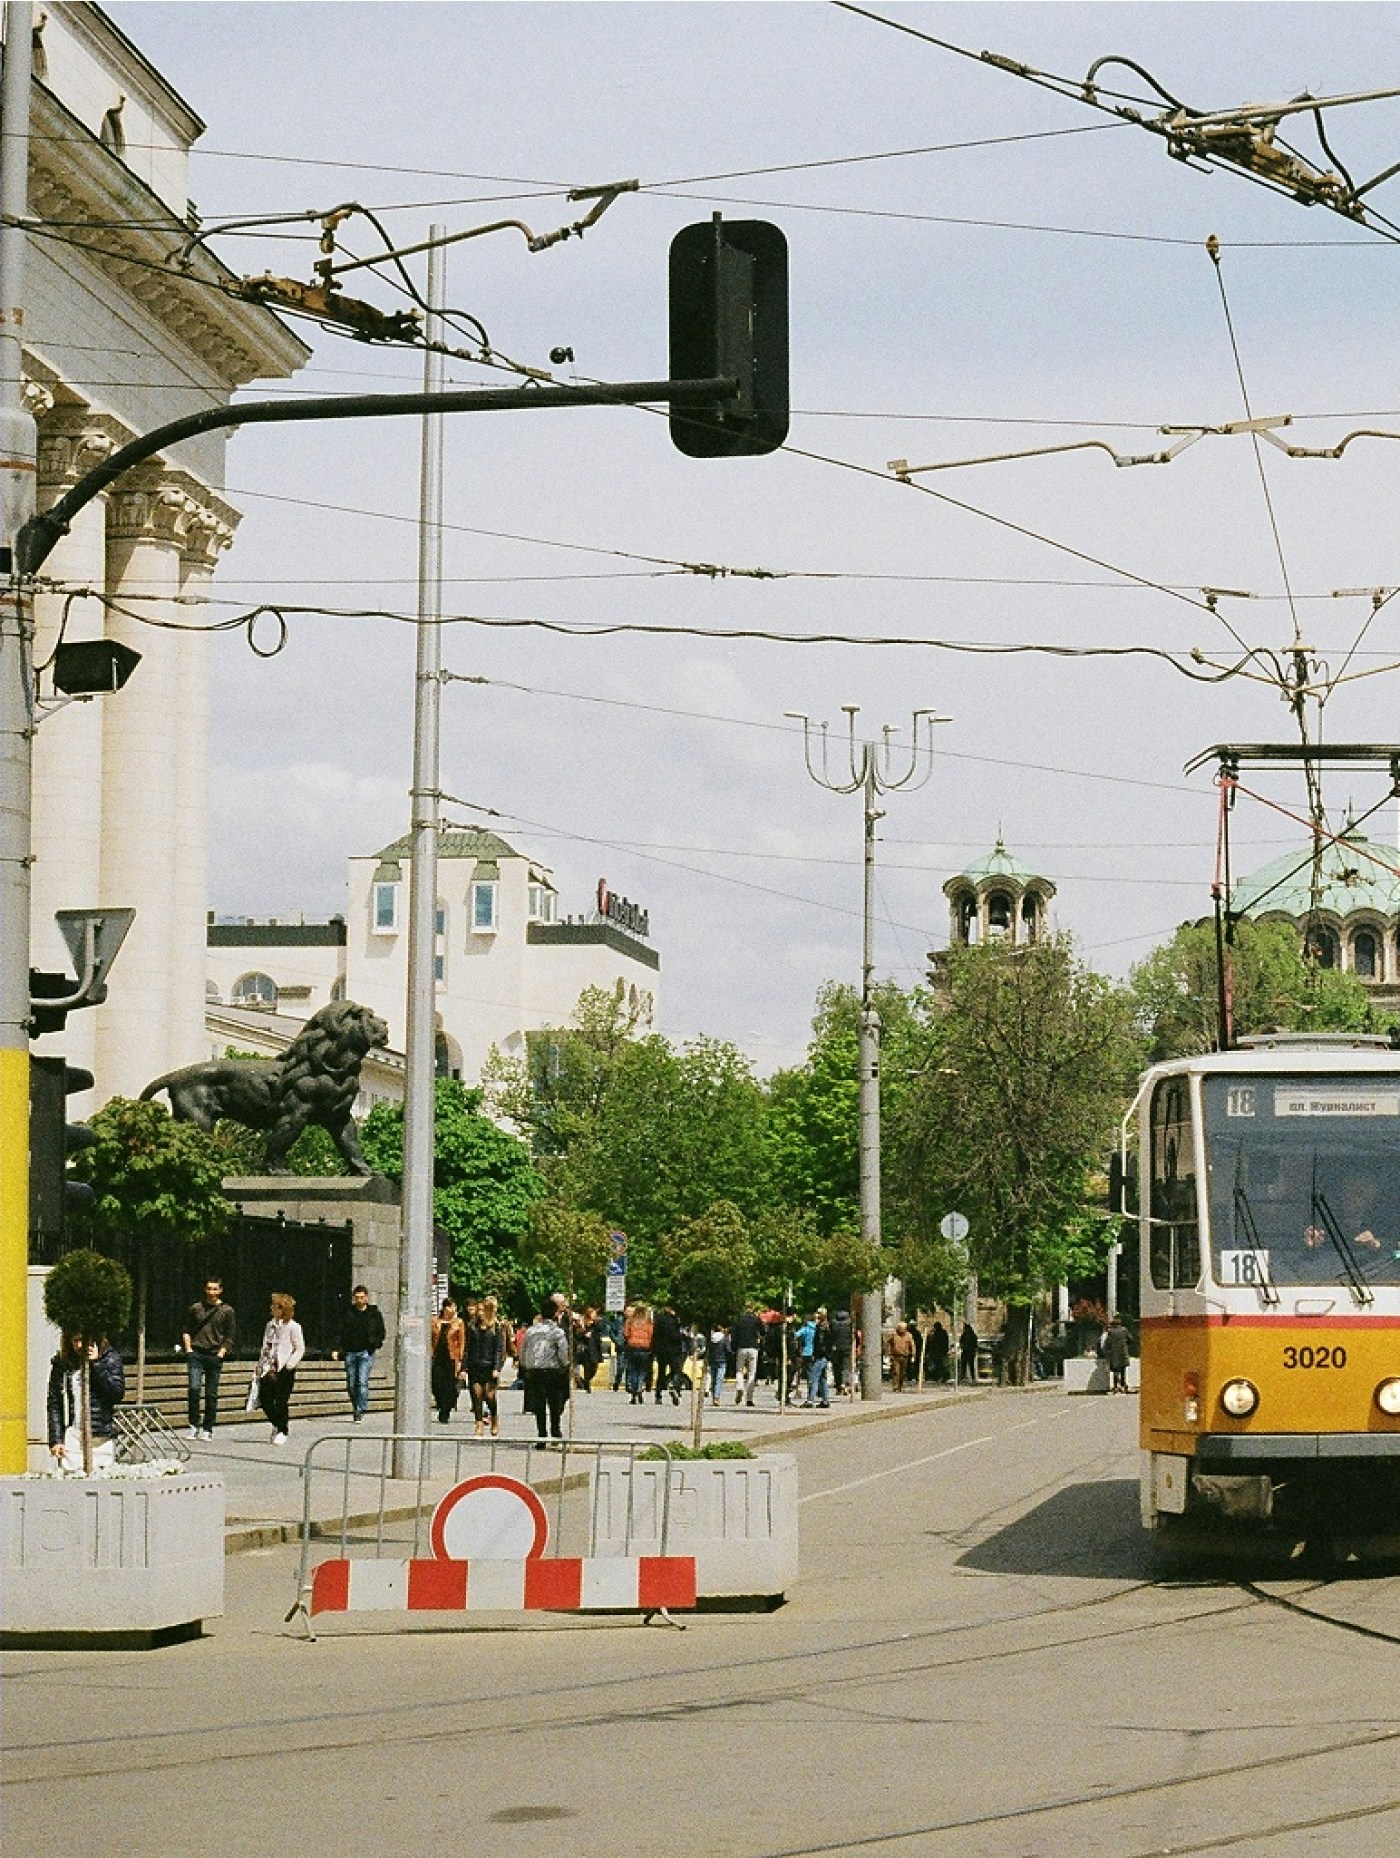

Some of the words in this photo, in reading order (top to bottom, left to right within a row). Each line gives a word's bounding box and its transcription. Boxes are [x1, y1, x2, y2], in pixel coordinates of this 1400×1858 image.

[1228, 1089, 1254, 1114] 18
[1289, 1102, 1307, 1112] пл.
[1309, 1101, 1376, 1113] Журналист
[1231, 1254, 1256, 1284] 18
[1283, 1346, 1347, 1368] 3020
